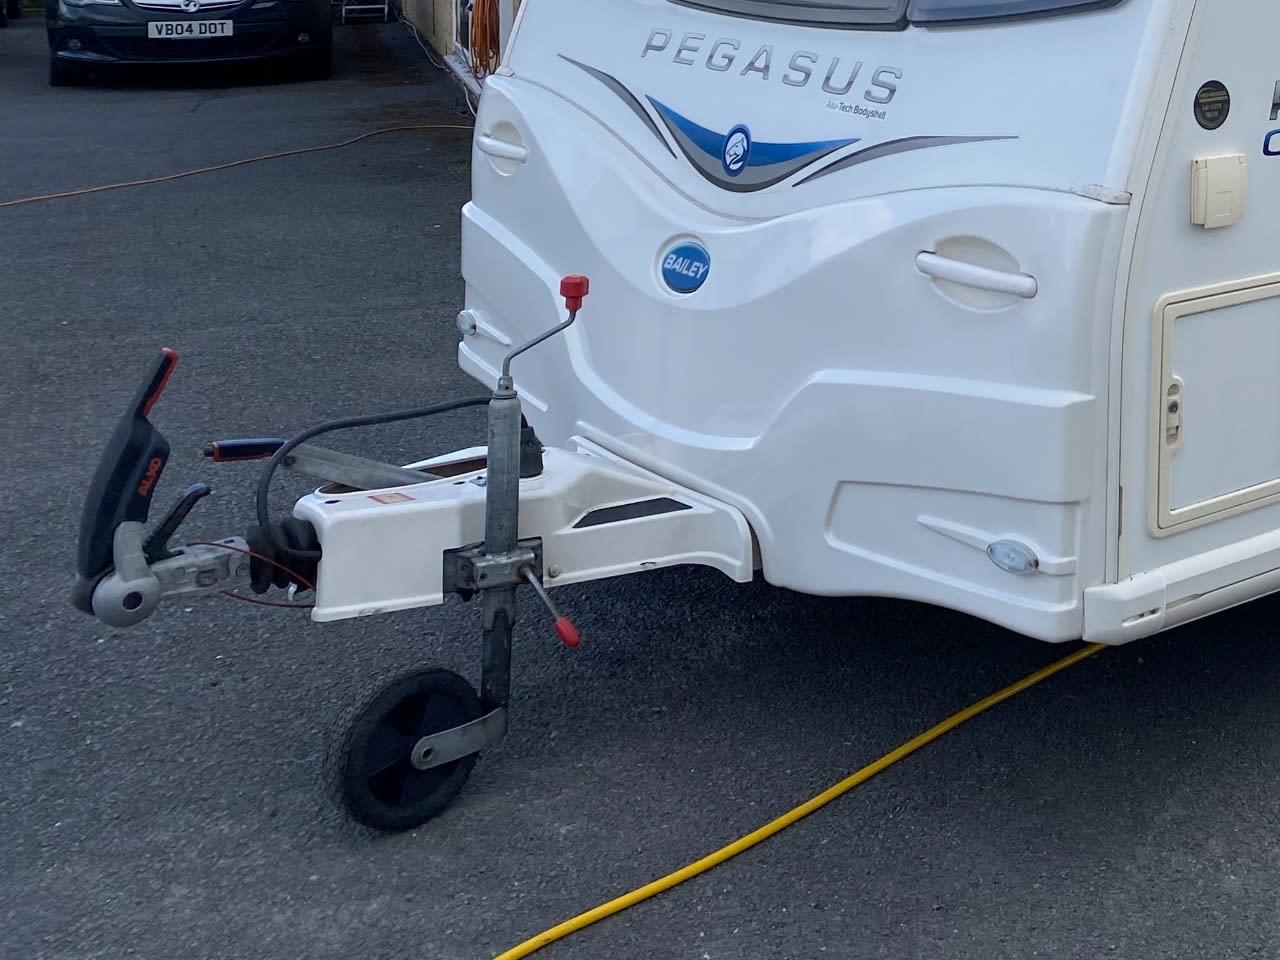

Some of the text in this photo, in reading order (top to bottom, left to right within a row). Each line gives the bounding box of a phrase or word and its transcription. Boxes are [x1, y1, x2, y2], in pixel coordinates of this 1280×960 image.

[155, 22, 227, 36] VB04 DOT
[640, 27, 904, 104] PEGASUS
[663, 253, 709, 279] BAILEY
